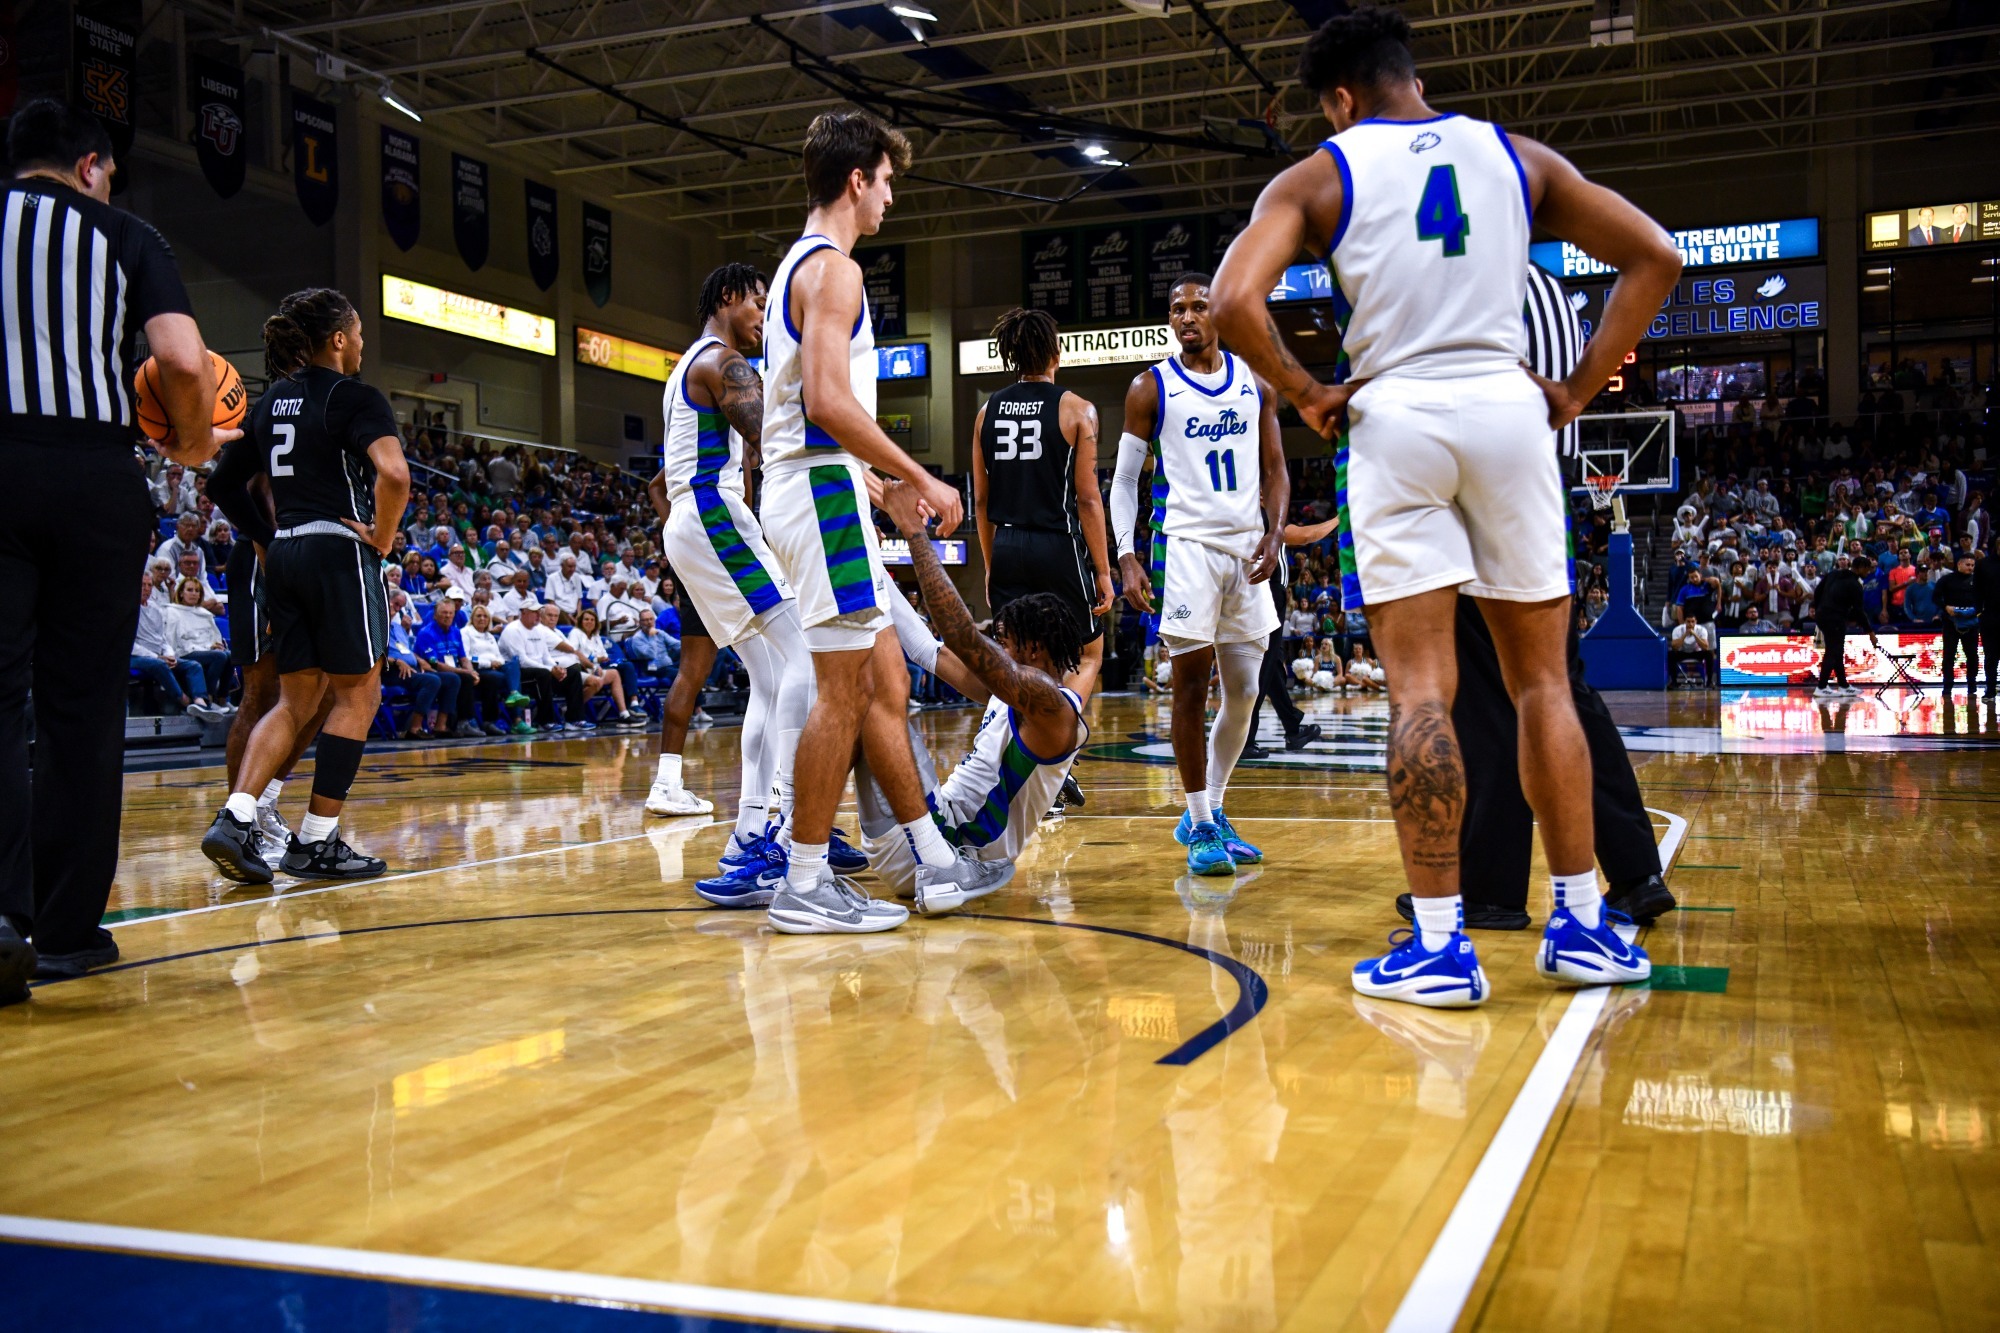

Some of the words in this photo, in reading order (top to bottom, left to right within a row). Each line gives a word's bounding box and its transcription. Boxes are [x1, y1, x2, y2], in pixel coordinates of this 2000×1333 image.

[75, 12, 134, 49] KENNESAW
[88, 33, 123, 57] STATE
[200, 75, 239, 100] LIBERTY
[302, 134, 329, 186] L
[1415, 163, 1470, 258] 4
[1982, 203, 1999, 211] The
[1710, 240, 1780, 264] SUITE
[1872, 240, 1899, 249] Advisors
[1097, 265, 1122, 277] NCAA
[1158, 260, 1184, 273] NCAA
[589, 335, 611, 365] 60
[1059, 327, 1168, 353] NTRACTORS
[271, 397, 304, 417] ORTIZ
[998, 400, 1045, 416] FORREST
[1184, 409, 1248, 442] Eagles
[270, 423, 296, 477] 2
[994, 419, 1043, 461] 33
[1204, 448, 1237, 492] 11
